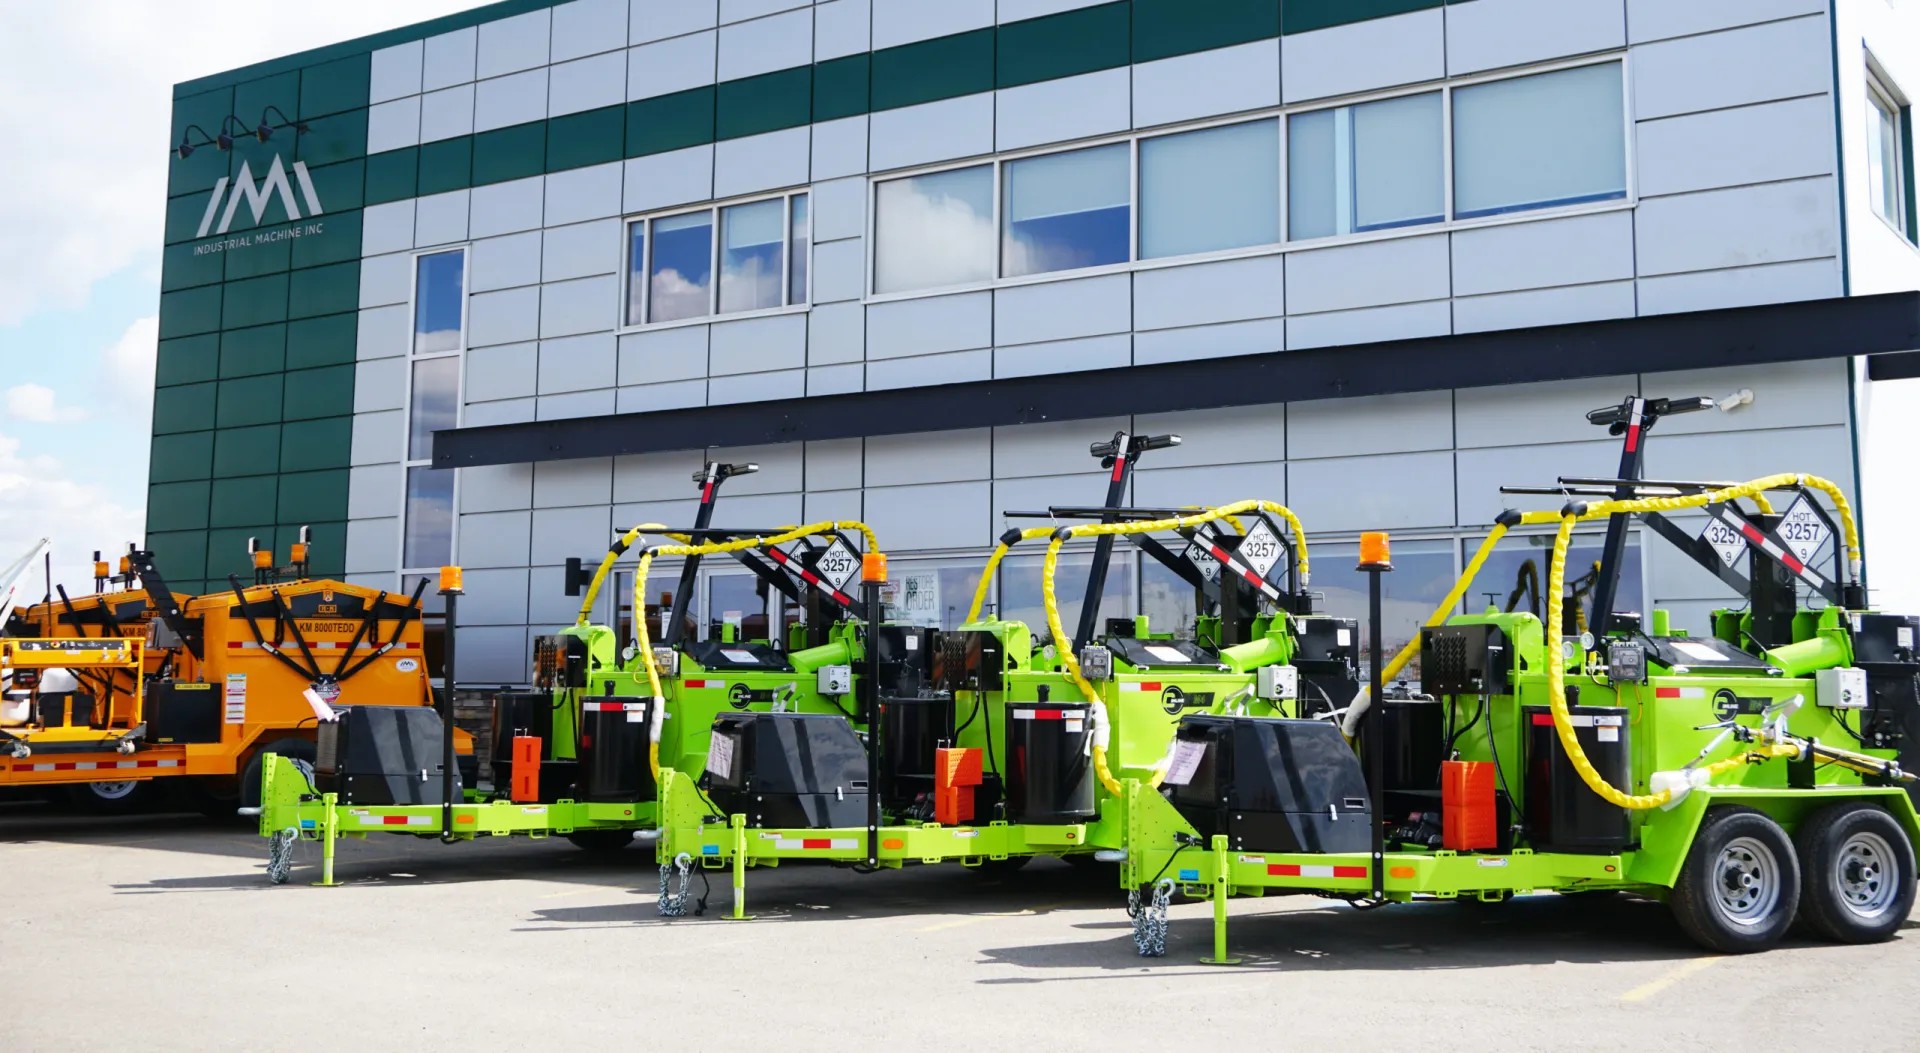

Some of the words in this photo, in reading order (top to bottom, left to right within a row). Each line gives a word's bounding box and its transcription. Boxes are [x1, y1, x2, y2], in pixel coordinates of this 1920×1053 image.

[193, 237, 251, 255] INDUSTRIAL
[255, 227, 301, 244] MACHINE
[305, 223, 324, 235] INC
[1792, 512, 1811, 521] HOT
[1785, 523, 1820, 540] 3257
[829, 550, 845, 558] HOT
[1246, 542, 1276, 557] 3257
[1800, 548, 1807, 559] 9
[1725, 551, 1732, 562] 9
[823, 558, 852, 572] 3257
[1259, 563, 1265, 573] 9
[1205, 567, 1211, 577] 9
[798, 579, 804, 588] 9
[835, 577, 841, 586] 9
[905, 575, 934, 590] RESTORE
[906, 590, 935, 611] ORDER
[122, 627, 136, 637] KM
[299, 623, 312, 633] KM
[314, 622, 355, 633] 8000TEDD
